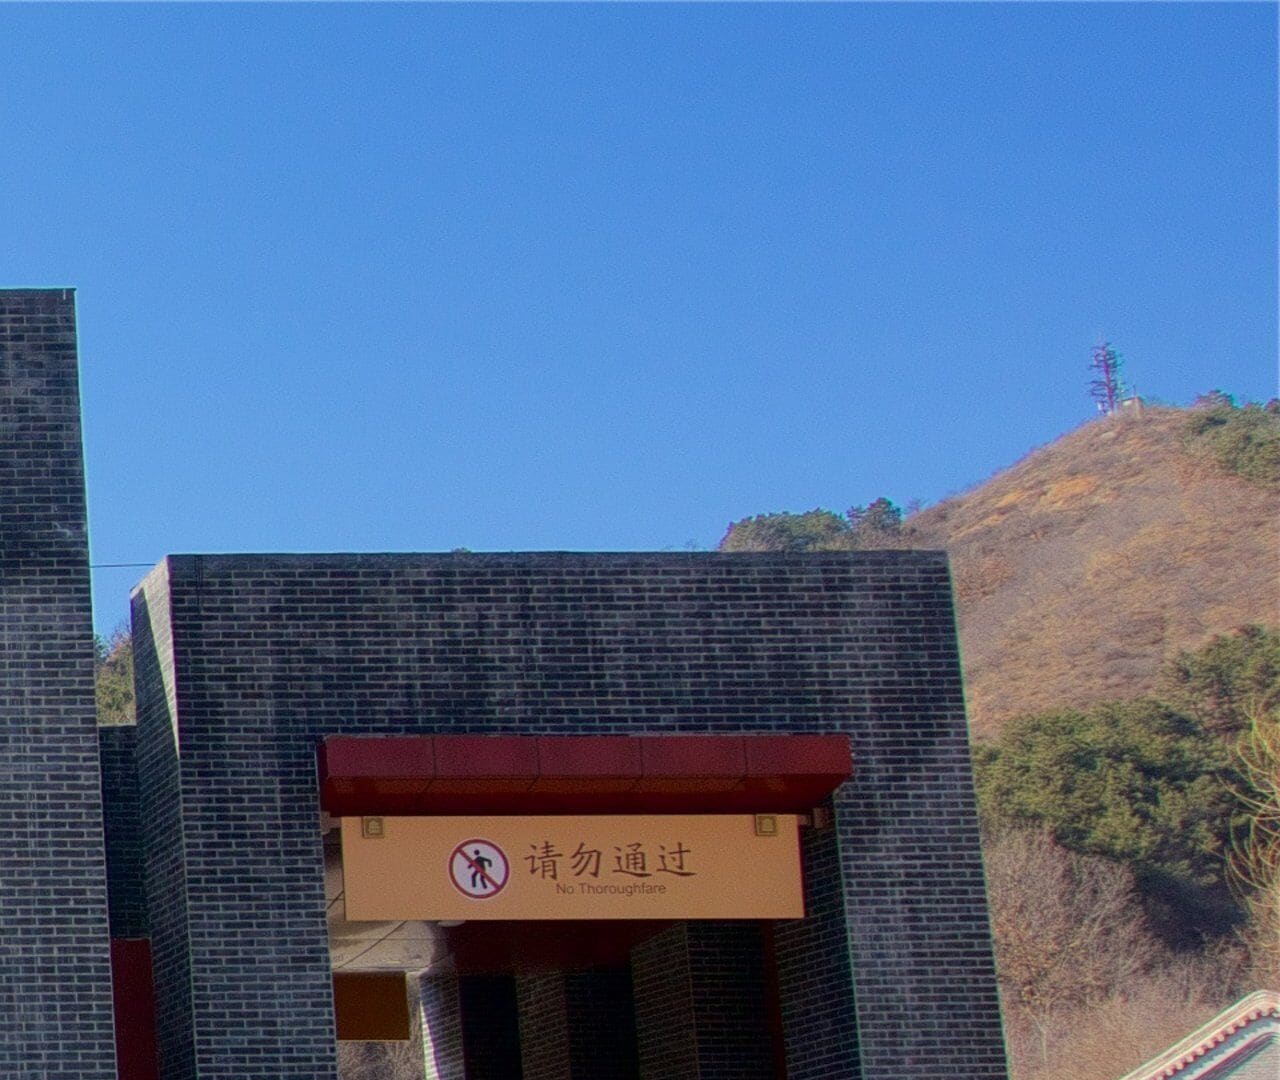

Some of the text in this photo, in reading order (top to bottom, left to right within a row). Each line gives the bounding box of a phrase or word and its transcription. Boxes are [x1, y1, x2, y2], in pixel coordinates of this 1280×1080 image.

[523, 841, 697, 881] 请勿通过
[555, 882, 667, 897] No Thoroughfare
